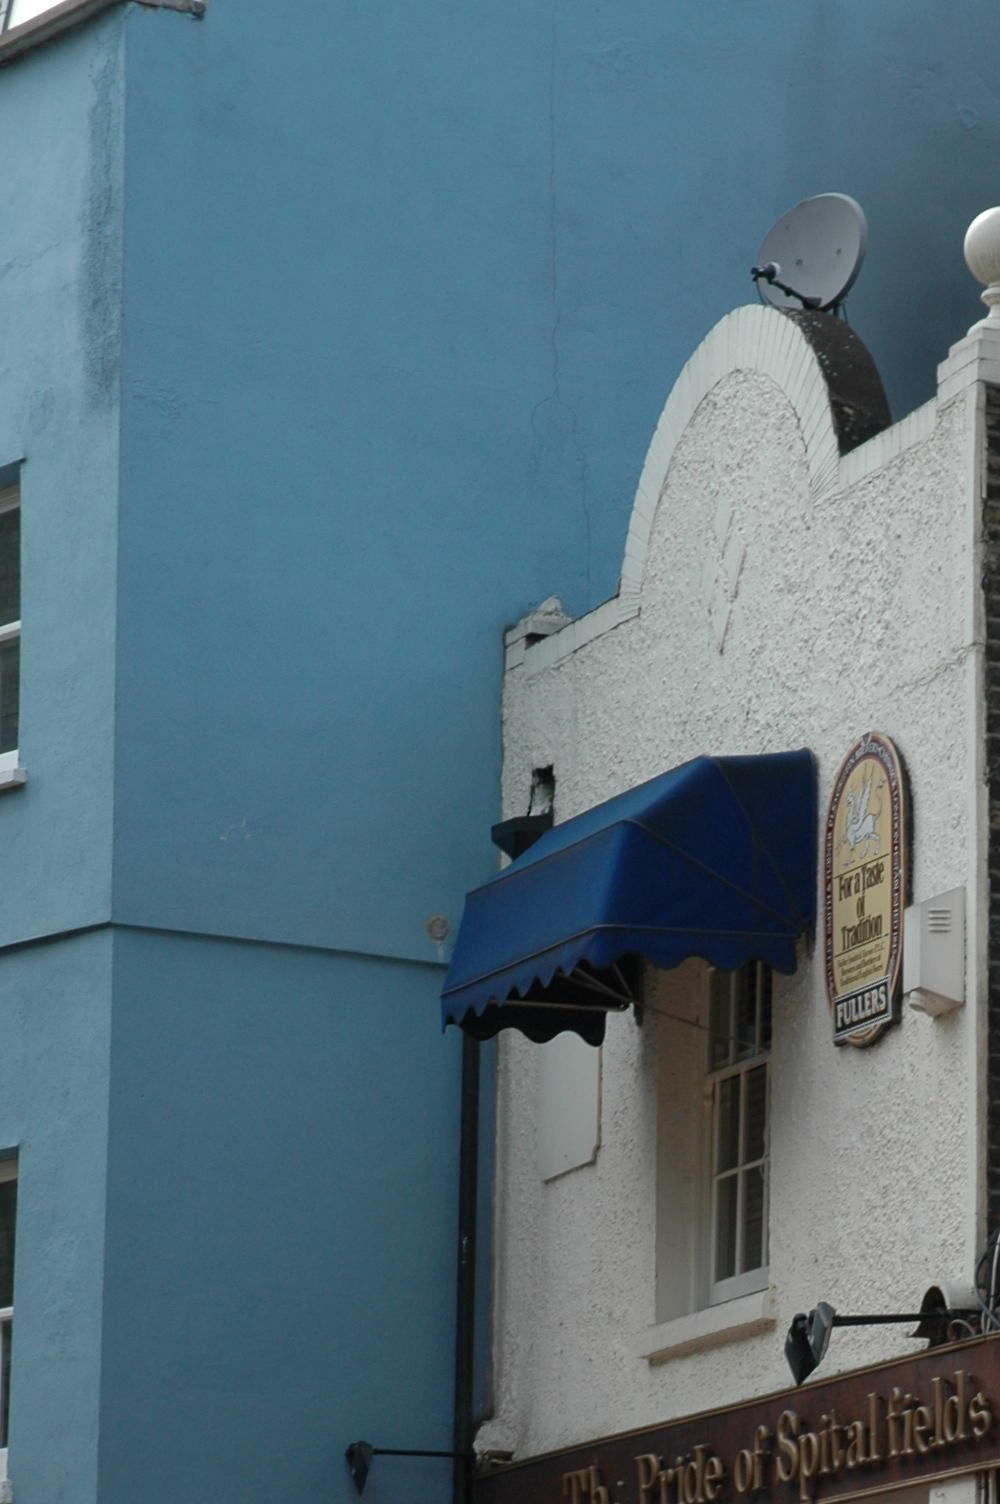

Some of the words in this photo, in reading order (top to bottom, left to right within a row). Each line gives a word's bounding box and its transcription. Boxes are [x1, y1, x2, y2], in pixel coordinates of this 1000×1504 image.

[841, 914, 883, 951] Tradition
[836, 984, 887, 1028] FULLERS
[734, 1424, 770, 1494] of
